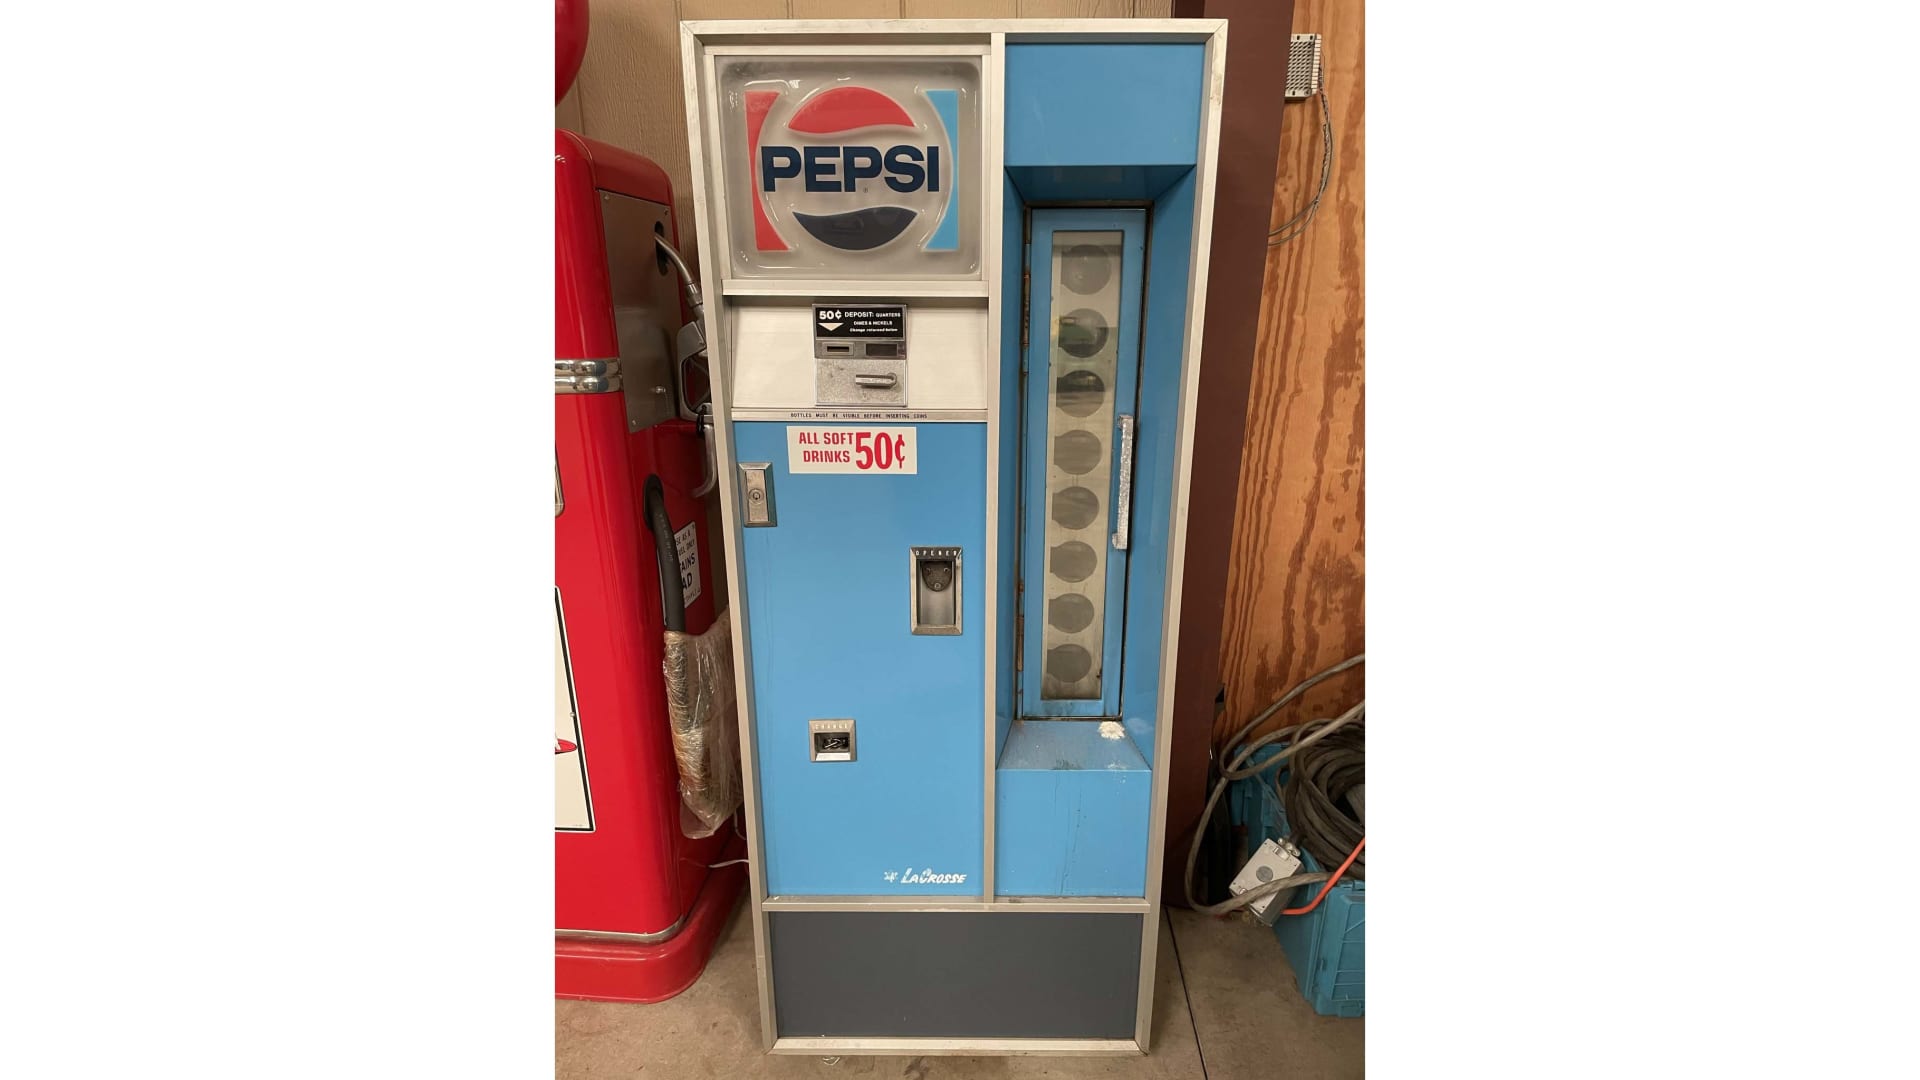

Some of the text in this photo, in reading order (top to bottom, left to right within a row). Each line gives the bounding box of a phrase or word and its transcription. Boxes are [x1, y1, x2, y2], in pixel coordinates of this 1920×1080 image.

[761, 145, 940, 193] PEPSI
[819, 309, 842, 320] 50¢
[799, 432, 854, 445] ALL SOFT
[803, 450, 850, 463] DRINKS
[855, 431, 906, 470] 50¢
